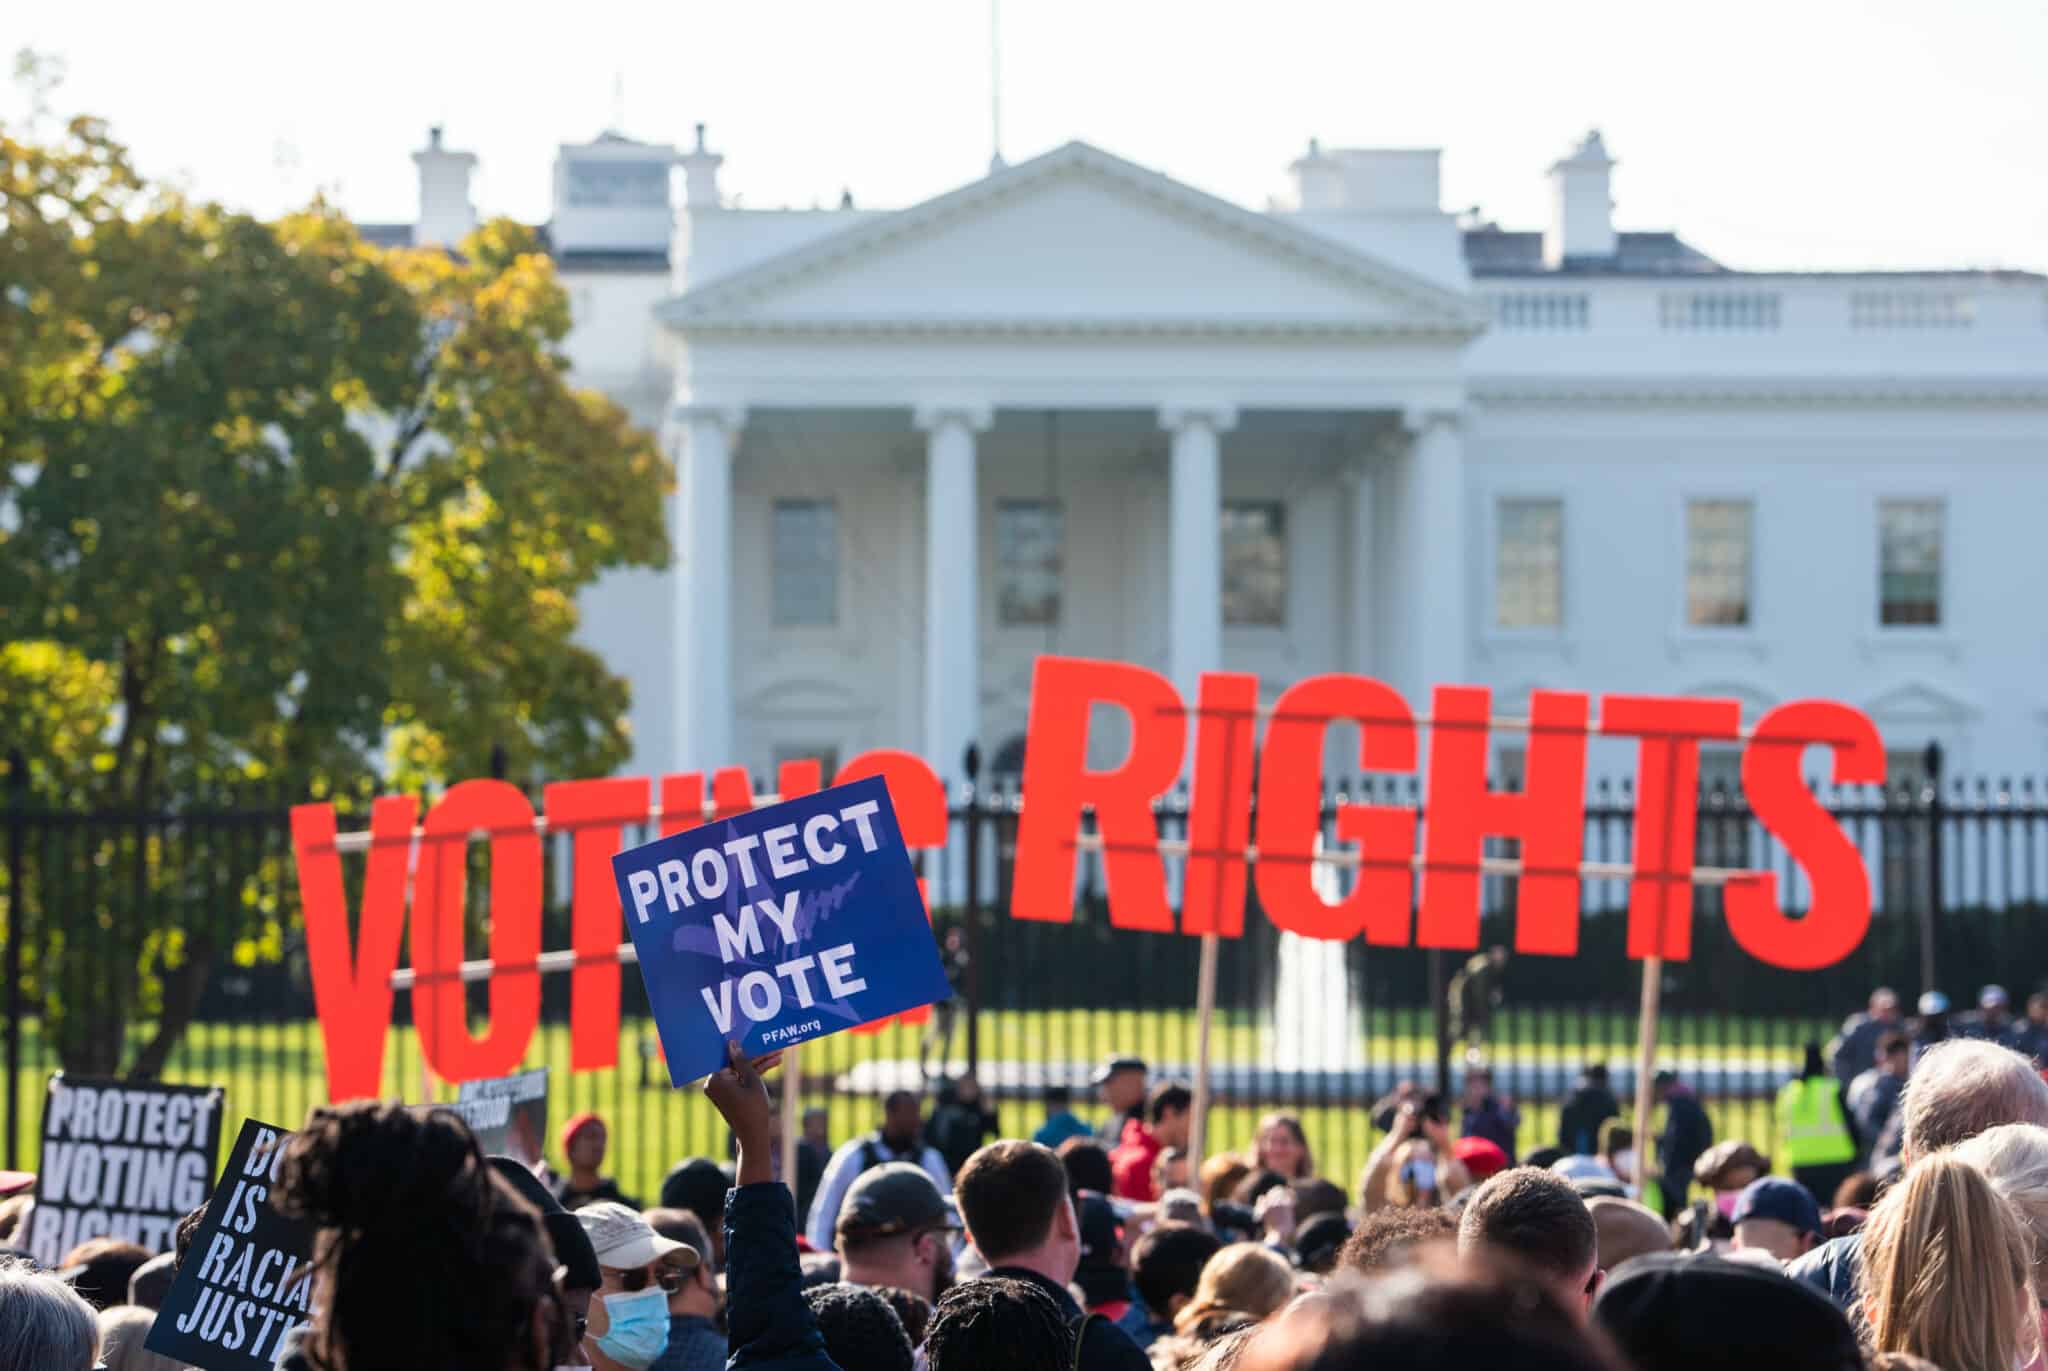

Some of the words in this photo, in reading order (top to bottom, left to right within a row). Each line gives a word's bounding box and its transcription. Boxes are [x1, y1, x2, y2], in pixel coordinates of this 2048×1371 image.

[1010, 655, 1886, 970] RIGHTS
[627, 799, 880, 923] PROTECT
[290, 749, 948, 1102] VOT
[712, 889, 800, 964] MY
[701, 943, 867, 1034] VOTE
[762, 1019, 822, 1045] PFAW.org
[48, 1086, 215, 1148] PROTECT
[42, 1140, 208, 1214] VOTING
[221, 1179, 267, 1234] IS
[30, 1204, 178, 1268] RIGHT
[198, 1231, 318, 1314] RACIA
[176, 1286, 304, 1363] JUSTI
